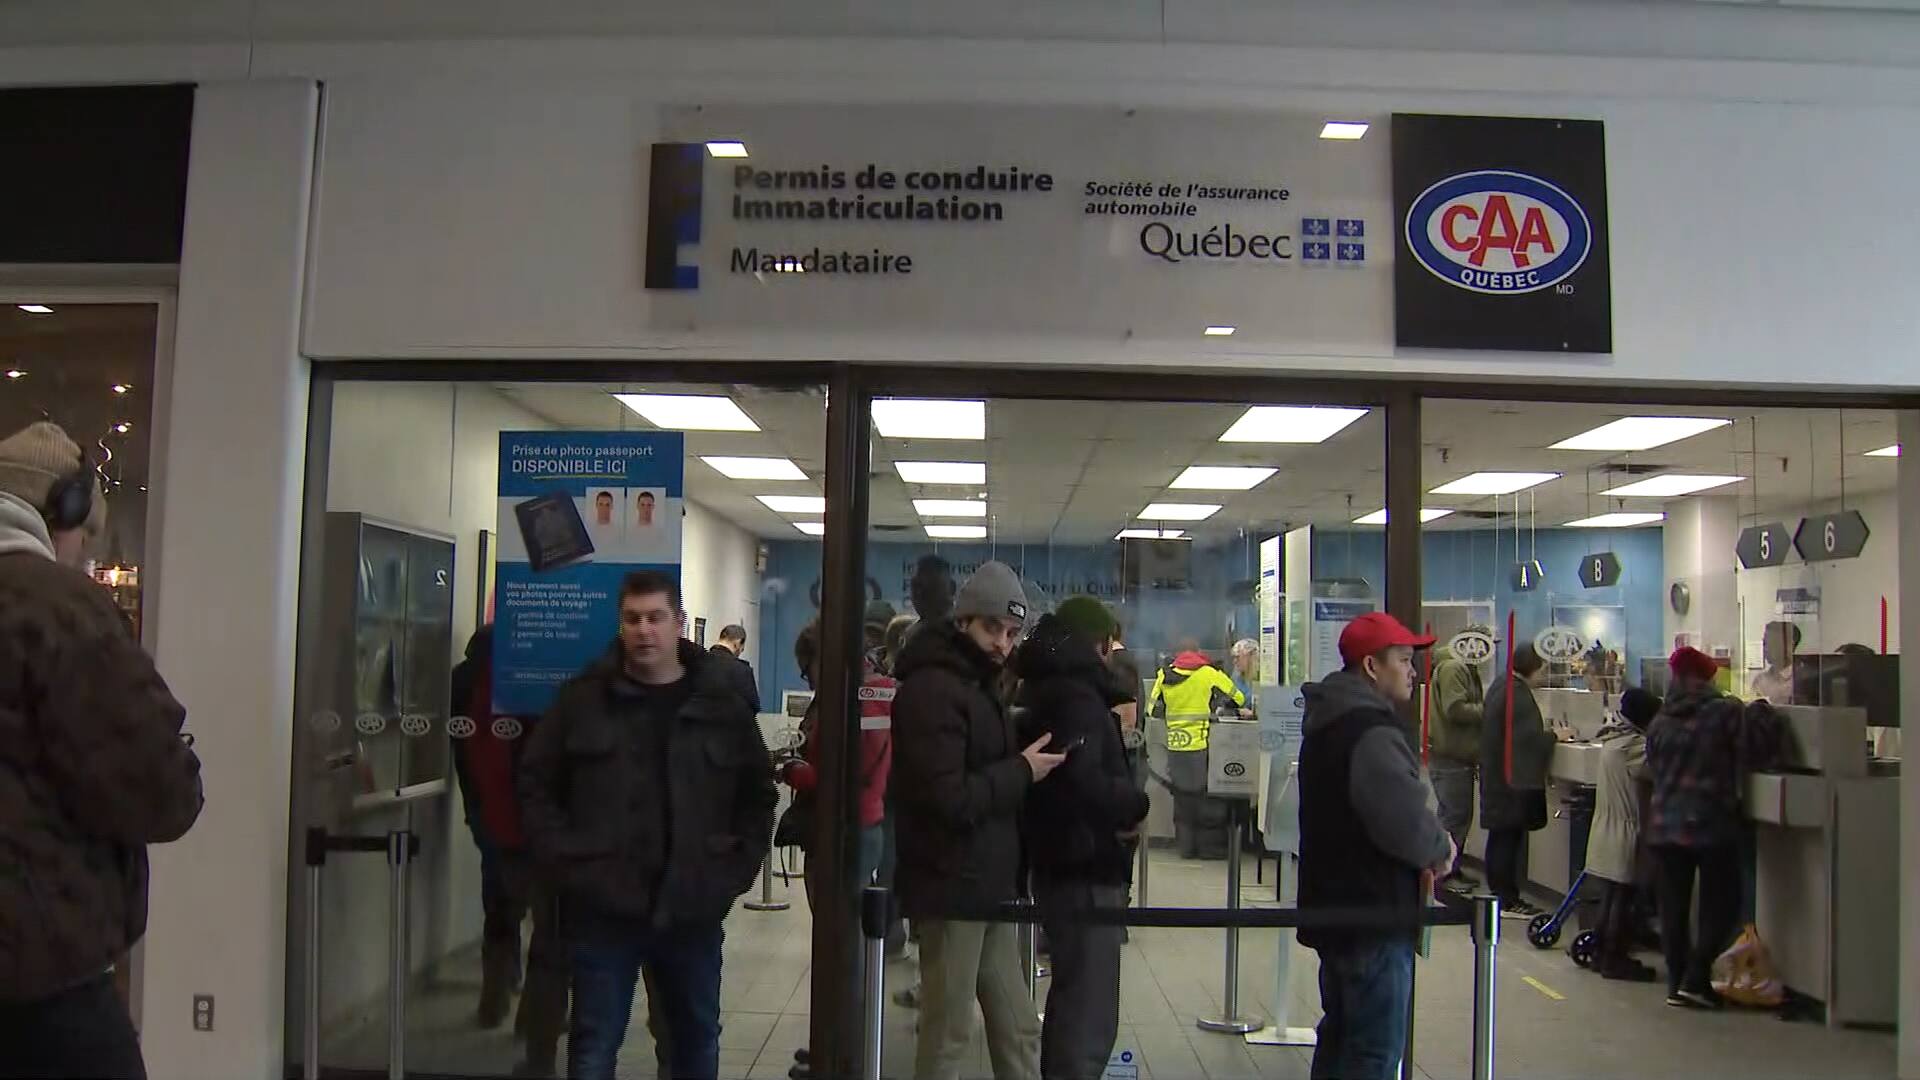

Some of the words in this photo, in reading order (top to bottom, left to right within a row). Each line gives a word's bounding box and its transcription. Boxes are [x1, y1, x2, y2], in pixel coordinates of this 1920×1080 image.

[733, 165, 846, 190] Permis
[855, 165, 896, 190] de
[904, 166, 1053, 191] conduire
[1084, 181, 1154, 198] Société
[1158, 183, 1183, 199] de
[1187, 183, 1290, 201] l'assurance
[733, 194, 1003, 221] Immatriculation
[1084, 201, 1197, 217] automobile
[1140, 222, 1292, 263] Québec
[1440, 195, 1555, 268] CAA
[730, 247, 913, 274] Mandataire
[1459, 268, 1541, 290] QUÉBEC
[1556, 284, 1574, 295] MD
[512, 445, 541, 455] Prise
[543, 445, 557, 455] de
[560, 445, 593, 457] photo
[595, 446, 653, 457] passeport
[512, 460, 603, 473] DISPONIBLE
[607, 460, 626, 473] ICI
[1760, 531, 1770, 559] 5
[1825, 522, 1835, 552] 6
[521, 591, 547, 600] photos
[548, 592, 567, 600] pour
[1456, 638, 1488, 659] CAA
